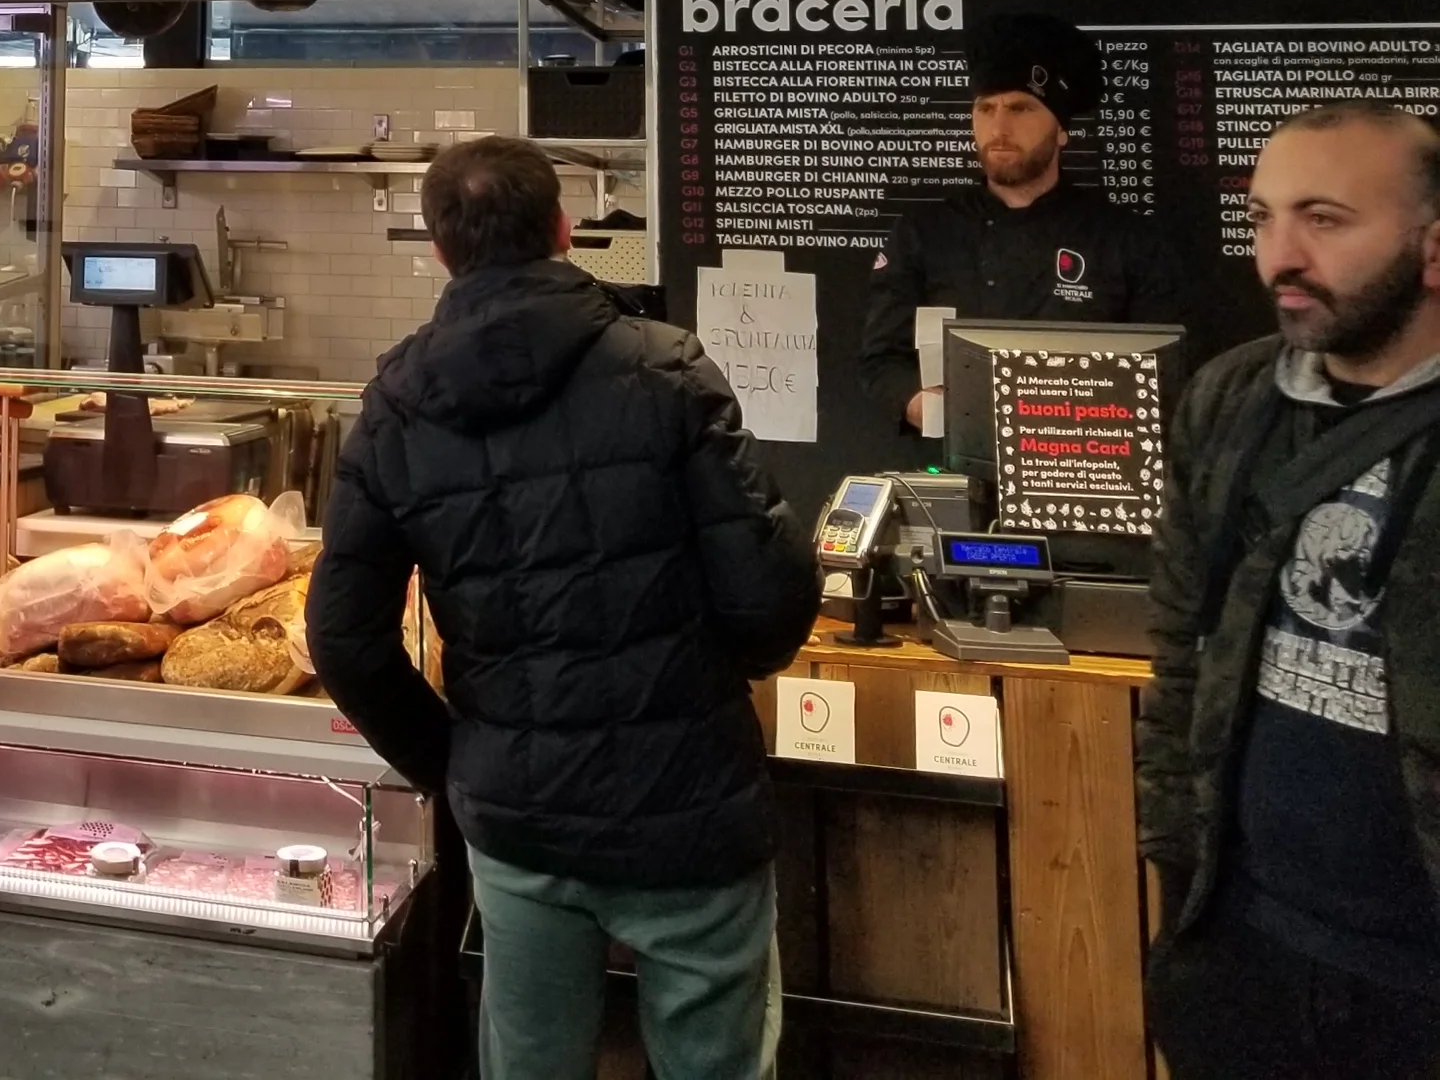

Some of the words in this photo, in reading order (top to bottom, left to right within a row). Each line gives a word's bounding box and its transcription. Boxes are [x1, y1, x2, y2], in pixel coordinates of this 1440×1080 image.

[712, 44, 797, 56] ARROSTICINI
[801, 45, 814, 56] DI
[818, 44, 874, 55] PECORA
[876, 46, 913, 55] (minimo
[915, 46, 936, 56] 5pz)
[1106, 41, 1148, 53] pezzo
[1213, 42, 1286, 53] TAGLIATA
[1289, 41, 1303, 52] DI
[1308, 41, 1366, 52] BOVINO
[1369, 41, 1431, 52] ADULTO
[713, 60, 778, 71] BISTECCA
[780, 60, 813, 71] ALLA
[816, 60, 897, 71] FIORENTINA
[900, 60, 914, 71] IN
[1233, 56, 1269, 66] scaglie
[1272, 56, 1281, 65] di
[1283, 56, 1345, 67] parmigiano,
[1348, 56, 1409, 65] pomodorini,
[713, 76, 778, 87] BISTECCA
[780, 76, 813, 87] ALLA
[816, 76, 897, 87] FIORENTINA
[900, 76, 931, 87] CON
[1214, 70, 1284, 81] TAGLIATA
[1286, 70, 1301, 81] DI
[1305, 70, 1354, 81] POLLO
[1358, 73, 1378, 81] 400
[1381, 74, 1392, 82] gr
[714, 92, 766, 103] FILETTO
[770, 92, 784, 103] DI
[788, 92, 839, 103] BOVINO
[842, 92, 897, 103] ADULTO
[900, 95, 917, 103] 250
[920, 96, 930, 104] gr
[1215, 87, 1283, 98] ETRUSCA
[1286, 87, 1363, 98] MARINATA
[1365, 87, 1402, 98] ALLA
[1405, 87, 1440, 98] BIRR
[714, 108, 784, 119] GRIGLIATA
[787, 108, 828, 119] MISTA
[830, 111, 858, 121] (pollo,
[860, 111, 901, 120] salsiccia,
[903, 111, 947, 122] pancetta,
[1099, 110, 1134, 121] 15,90
[1139, 110, 1151, 120] €
[714, 123, 778, 134] GRIGLIATA
[780, 123, 818, 134] MISTA
[1097, 126, 1135, 137] 25,90
[1139, 127, 1151, 137] €
[1216, 121, 1272, 132] STINCO
[714, 139, 800, 150] HAMBURGER
[803, 140, 818, 151] DI
[821, 140, 873, 151] BOVINO
[877, 141, 932, 152] ADULTO
[1106, 142, 1136, 153] 9,90
[1140, 142, 1152, 153] €
[715, 155, 800, 166] HAMBURGER
[804, 156, 818, 167] DI
[821, 156, 864, 167] SUINO
[868, 157, 909, 167] CINTA
[912, 157, 964, 168] SENESE
[1101, 160, 1137, 171] 12,90
[1140, 160, 1153, 170] €
[715, 170, 800, 182] HAMBURGER
[805, 171, 819, 183] DI
[822, 172, 889, 184] CHIANINA
[892, 176, 908, 184] 220
[911, 178, 920, 186] gr
[923, 177, 940, 185] con
[942, 176, 973, 186] patate
[1103, 176, 1138, 187] 13,90
[1142, 176, 1154, 186] €
[715, 186, 763, 197] MEZZO
[766, 187, 811, 199] POLLO
[814, 188, 885, 200] RUSPANTE
[1108, 192, 1139, 203] 9,90
[1143, 193, 1155, 203] €
[715, 202, 786, 214] SALSICCIA
[788, 203, 853, 215] TOSCANA
[855, 207, 878, 217] (2pz)
[716, 218, 772, 230] SPIEDINI
[776, 219, 813, 230] MISTI
[716, 233, 777, 246] TAGLIATA
[780, 234, 793, 246] DI
[797, 235, 847, 247] BOVINO
[850, 236, 889, 248] ADUL
[1053, 289, 1093, 299] CENTRALE
[1016, 376, 1027, 385] Al
[1029, 376, 1070, 386] Mercato
[1071, 378, 1114, 387] Centrale
[1017, 387, 1039, 397] puoi
[1074, 388, 1094, 397] tuoi
[1018, 400, 1071, 417] buoni
[1075, 404, 1134, 421] pasto.
[1019, 426, 1036, 435] Per
[1037, 426, 1084, 436] utilizzarli
[1085, 427, 1123, 437] richiedi
[1123, 429, 1134, 438] la
[1020, 438, 1082, 456] Magna
[1086, 441, 1131, 456] Card
[1021, 457, 1034, 466] La
[1034, 458, 1058, 467] trovi
[1059, 458, 1120, 470] all'infopoint,
[1022, 470, 1039, 479] per
[1040, 470, 1075, 480] godere
[1077, 470, 1087, 479] di
[1088, 472, 1122, 482] questo
[1031, 479, 1054, 488] tanti
[1055, 480, 1088, 490] servizi
[1089, 482, 1135, 492] esclusivi.
[794, 741, 837, 753] CENTRALE
[934, 756, 978, 767] CENTRALE
